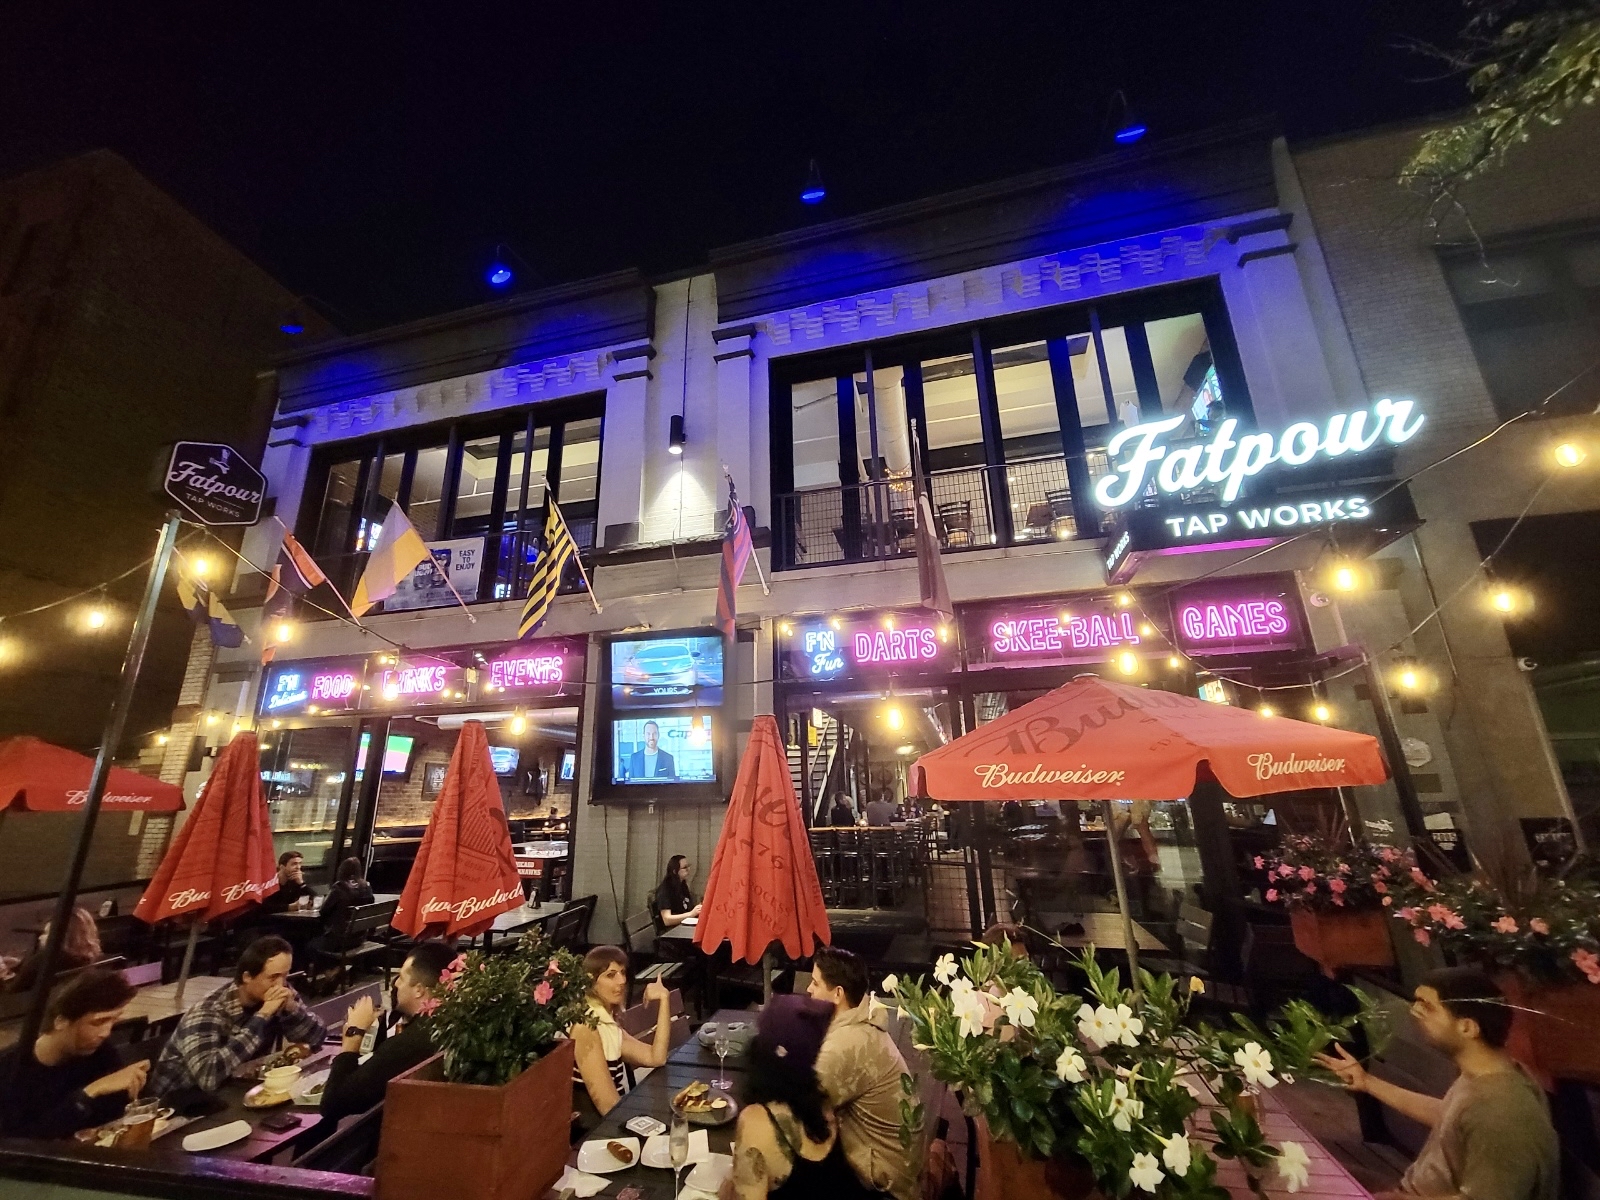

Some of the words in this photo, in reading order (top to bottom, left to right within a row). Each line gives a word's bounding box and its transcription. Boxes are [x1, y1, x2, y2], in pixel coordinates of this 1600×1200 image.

[1095, 398, 1425, 507] Fatpour
[168, 461, 261, 503] Fatpour
[186, 493, 204, 503] TAP
[207, 501, 240, 518] WORKS
[1166, 515, 1228, 537] TAP
[1238, 498, 1370, 529] WORKS
[455, 563, 475, 571] ENJOY
[459, 549, 476, 557] EASY
[462, 556, 471, 564] TO
[992, 612, 1140, 653] SKEE-BALL
[1182, 601, 1288, 640] GAMES
[855, 627, 937, 663] DARTS
[490, 655, 563, 688] EVENTS
[811, 652, 844, 674] Fun
[312, 674, 355, 700] FOOD
[974, 763, 1125, 788] Budweiser
[1247, 752, 1345, 780] Budweiser
